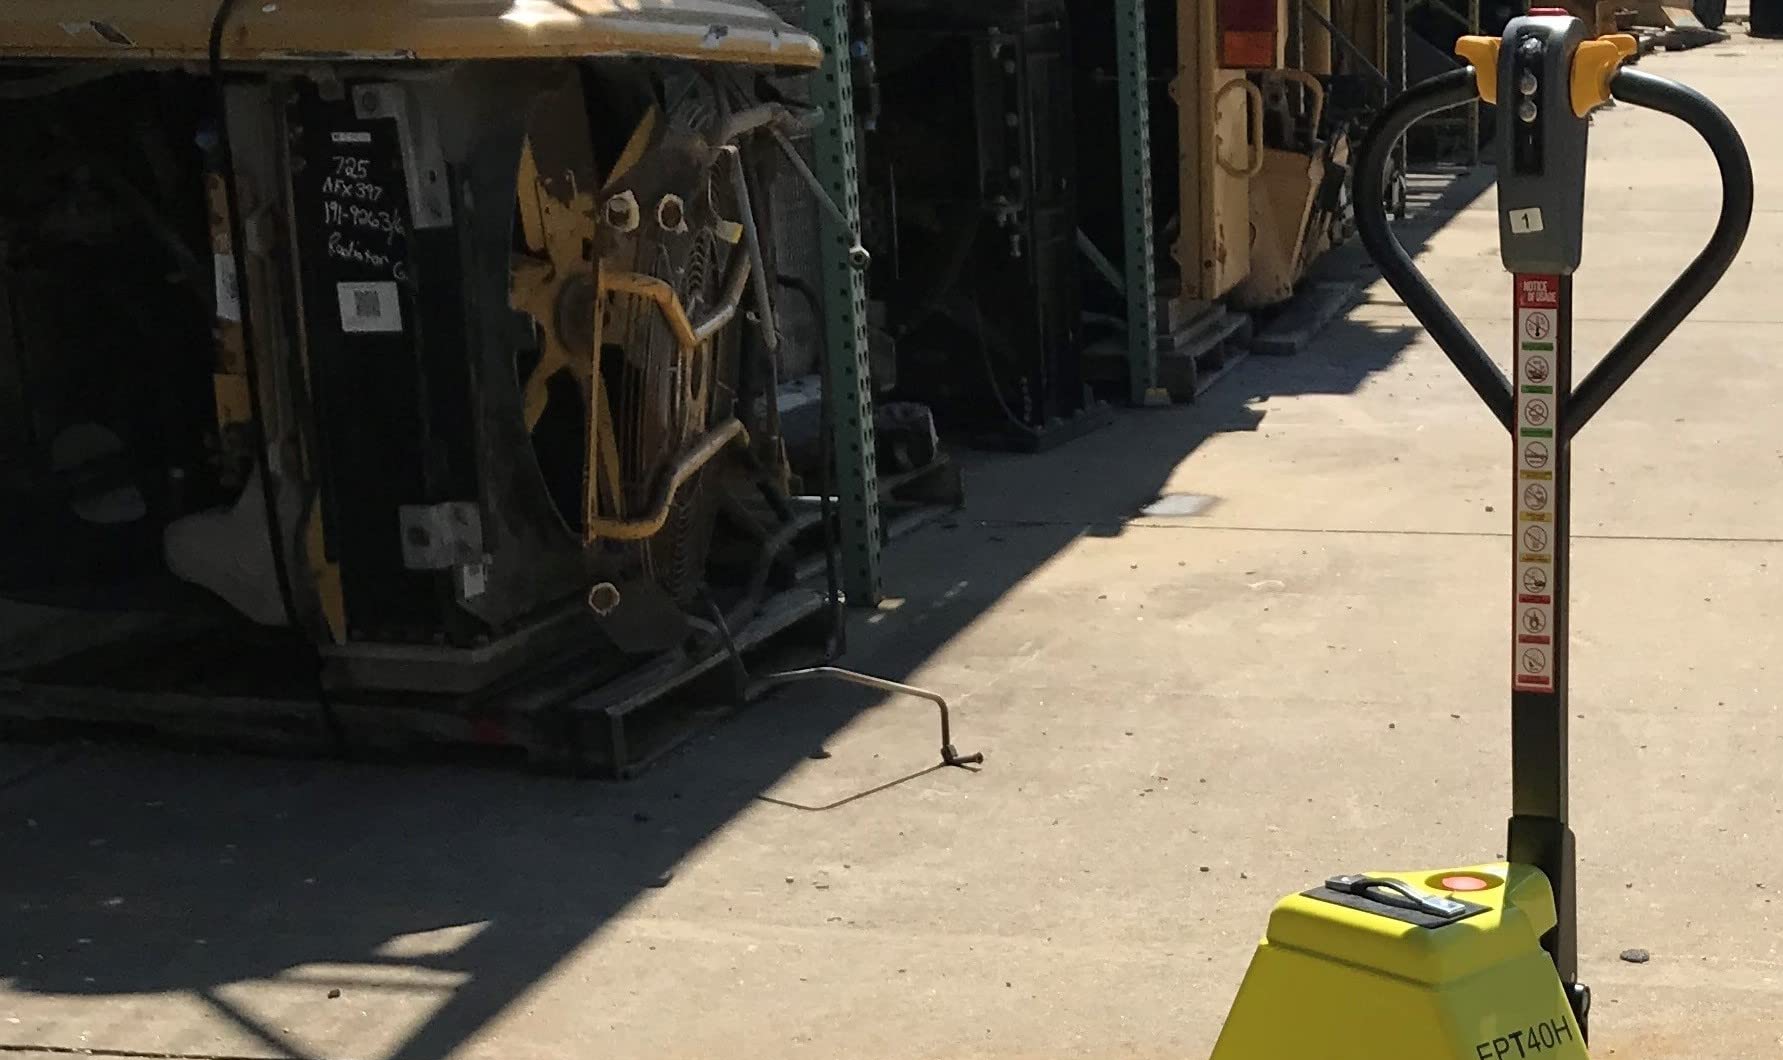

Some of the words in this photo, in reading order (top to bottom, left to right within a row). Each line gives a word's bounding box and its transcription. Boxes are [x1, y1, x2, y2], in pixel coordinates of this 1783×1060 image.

[332, 156, 371, 179] 725
[1521, 213, 1529, 229] 1
[1523, 281, 1547, 291] NOTICE
